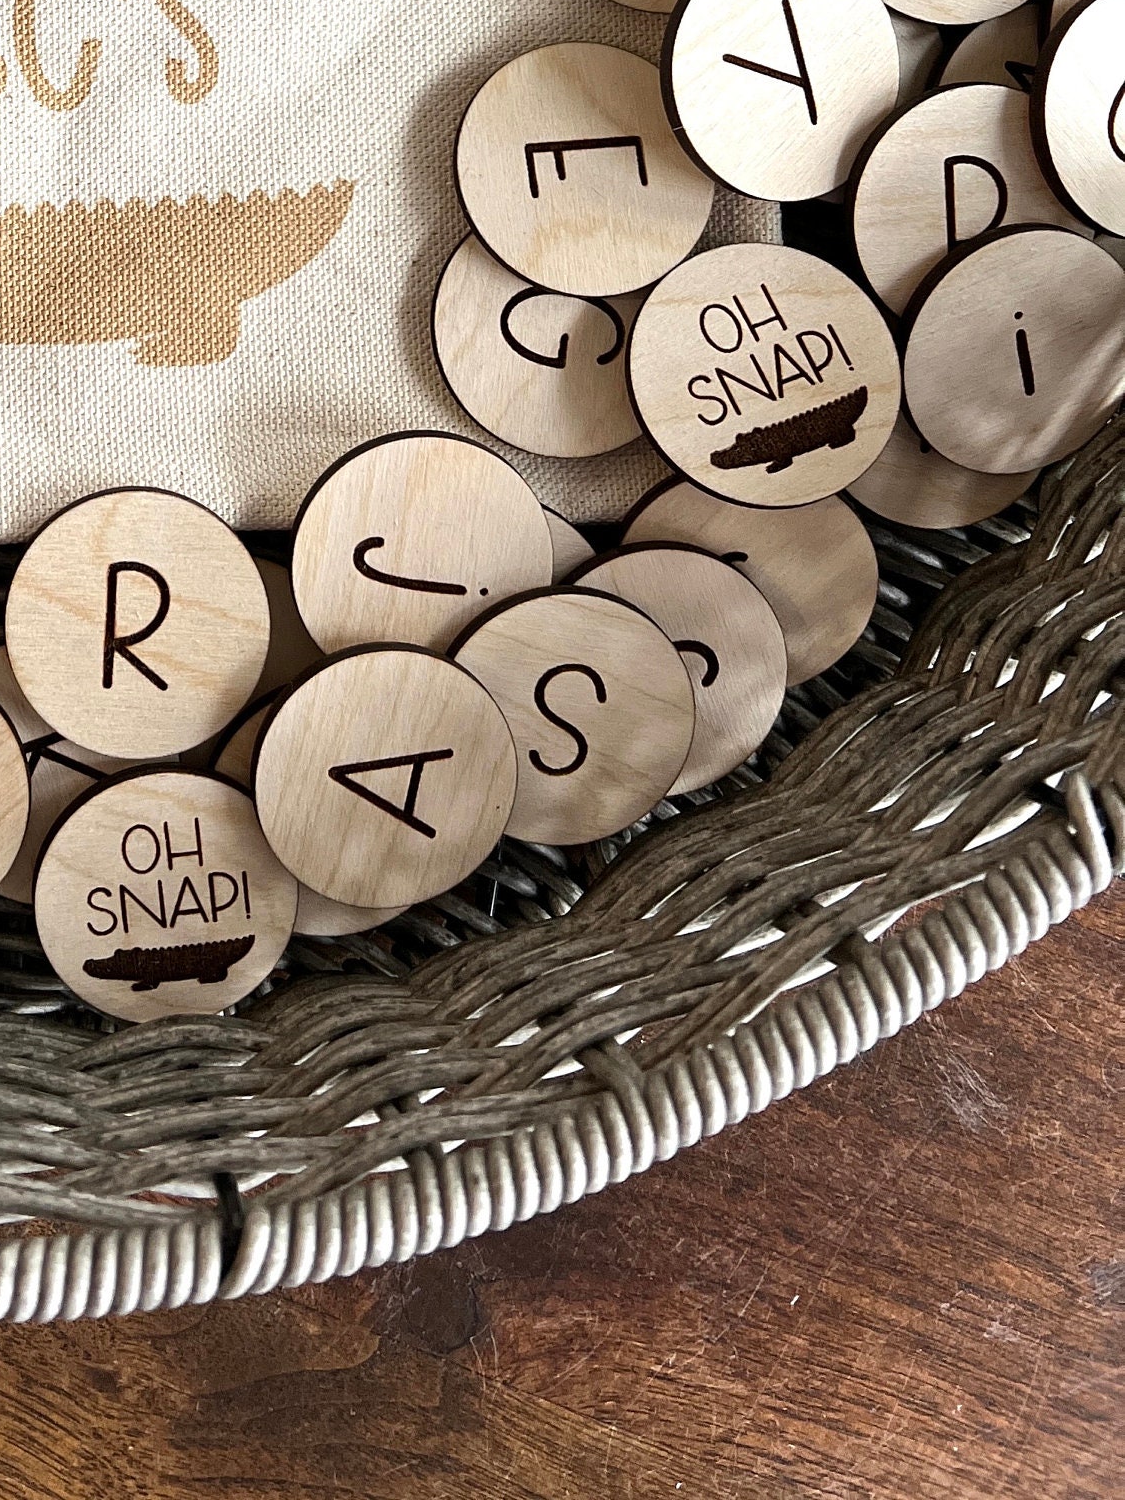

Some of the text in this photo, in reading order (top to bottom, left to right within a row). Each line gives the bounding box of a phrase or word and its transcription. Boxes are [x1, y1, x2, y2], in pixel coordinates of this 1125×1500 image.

[525, 135, 648, 198] E
[698, 283, 787, 354] OH
[1013, 310, 1035, 397] i
[687, 324, 855, 427] SNAP!
[102, 561, 172, 691] R
[327, 748, 454, 839] A
[120, 817, 205, 875] OH
[86, 870, 251, 936] SNAP!
